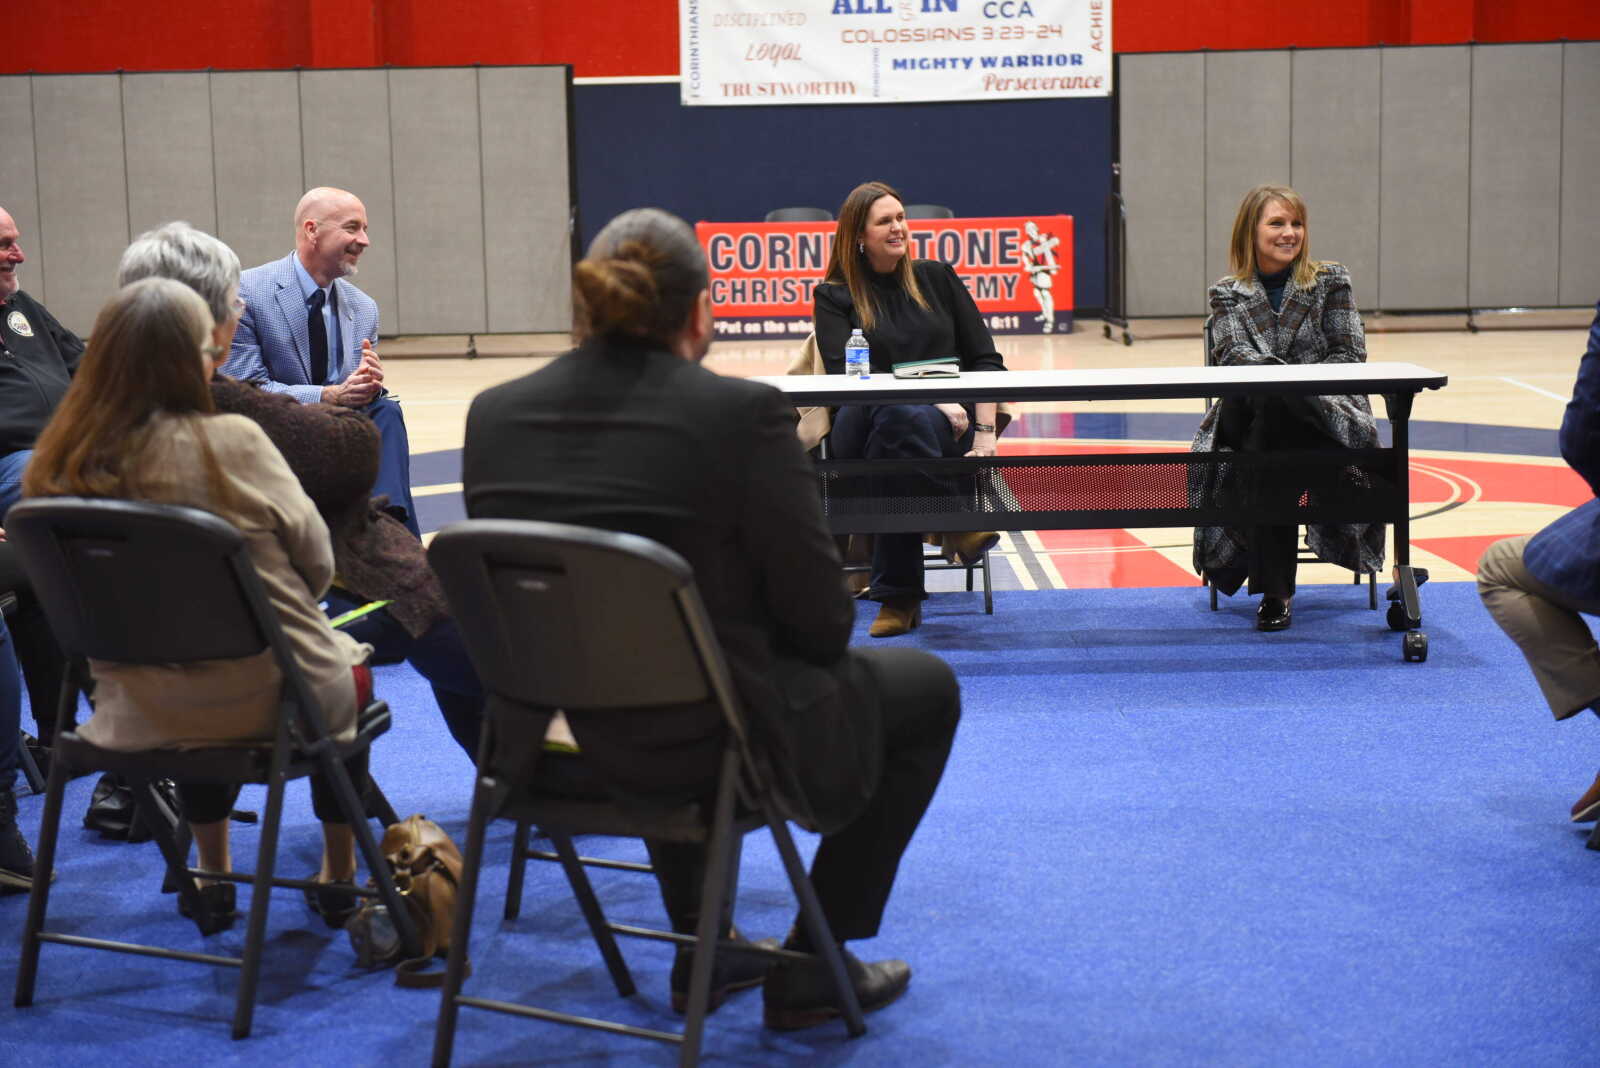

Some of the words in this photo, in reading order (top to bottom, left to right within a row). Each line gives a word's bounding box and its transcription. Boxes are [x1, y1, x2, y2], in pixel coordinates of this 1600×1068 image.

[832, 0, 892, 14] ALL
[920, 0, 958, 12] IN
[983, 1, 1034, 19] CCA
[713, 12, 807, 28] DISCIPLINED
[841, 28, 975, 43] COLOSSIANS
[892, 57, 973, 70] MIGHTY
[980, 54, 1083, 68] WARRIOR
[720, 82, 856, 97] TRUSTWORTHY
[982, 73, 1103, 92] Perseverance
[711, 278, 822, 304] CHRIST
[763, 320, 786, 333] the
